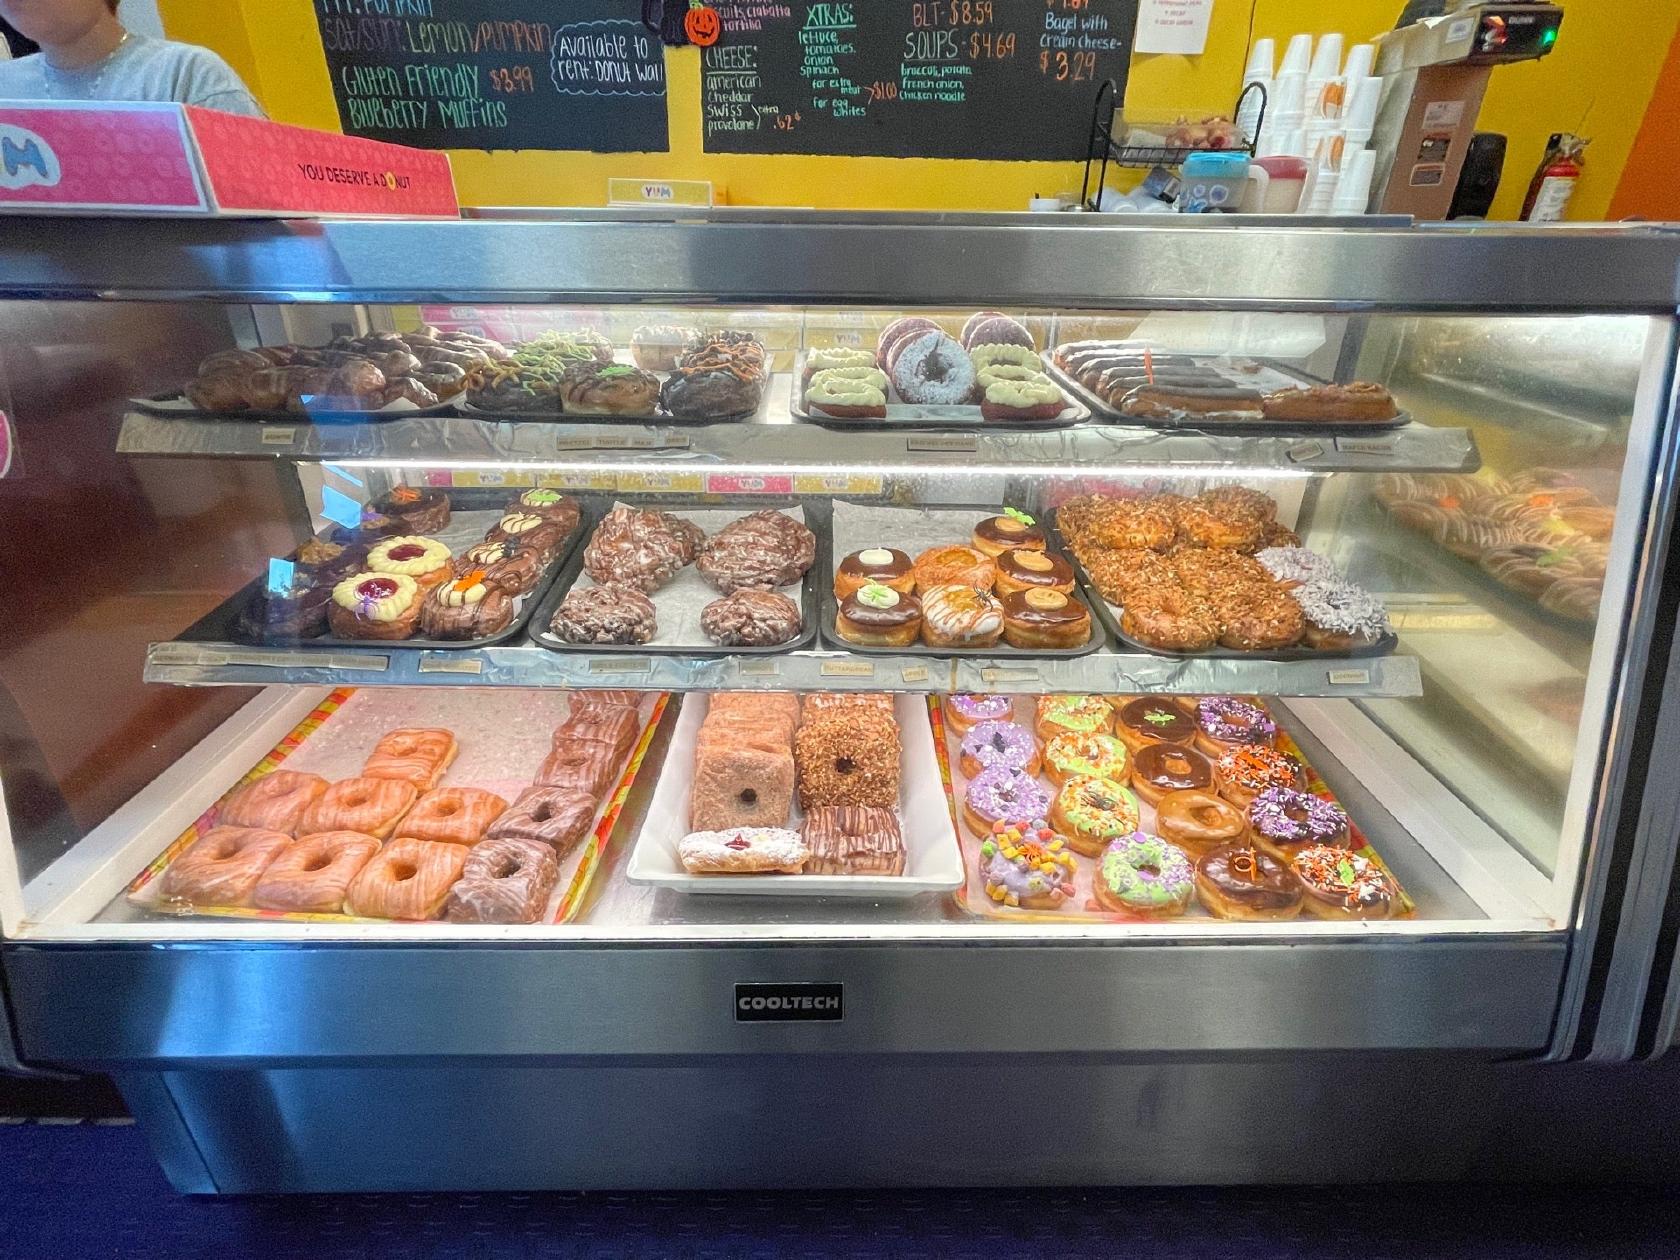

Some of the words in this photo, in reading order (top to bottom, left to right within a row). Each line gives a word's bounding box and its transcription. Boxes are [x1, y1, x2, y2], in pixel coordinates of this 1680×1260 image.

[805, 2, 854, 28] XTRAS:
[949, 0, 994, 26] $8.59
[1045, 11, 1077, 35] Bagel
[1081, 14, 1108, 32] with
[560, 33, 628, 59] Available
[633, 35, 648, 59] to
[705, 45, 758, 70] CHEESE:
[969, 31, 1016, 59] $4.69
[490, 65, 534, 94] $3.99
[557, 59, 594, 80] rent:
[297, 164, 324, 181] YOU
[325, 166, 371, 187] DESERVE
[372, 173, 380, 187] A
[645, 186, 672, 199] YUM
[738, 996, 840, 1011] COOLTECH
